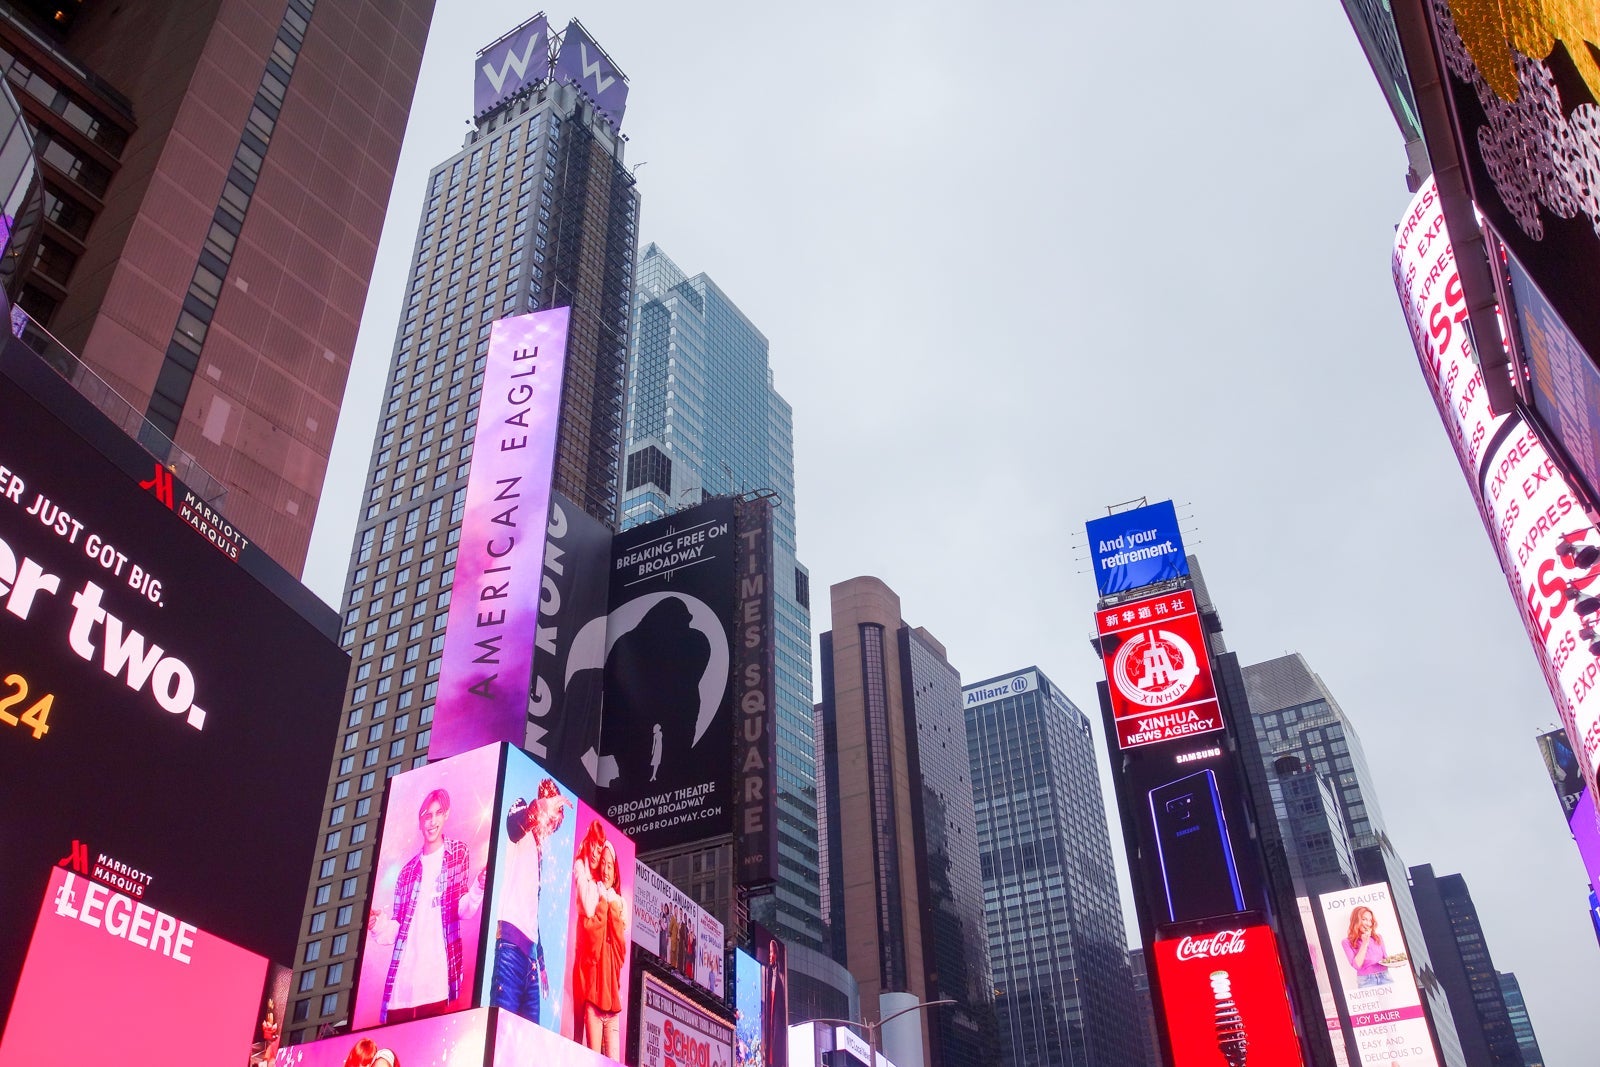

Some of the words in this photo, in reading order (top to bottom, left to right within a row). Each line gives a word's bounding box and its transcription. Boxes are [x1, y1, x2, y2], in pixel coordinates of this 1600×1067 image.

[482, 32, 539, 94] W
[580, 41, 616, 95] W
[181, 508, 239, 559] MARQUIS
[185, 491, 249, 550] MARRIOTT
[467, 476, 522, 700] AMERICAN
[501, 345, 539, 452] EAGLE
[26, 494, 84, 544] JUST
[85, 534, 128, 577] GOT
[128, 564, 164, 608] BIG.
[616, 542, 674, 570] BREAKING
[676, 530, 705, 549] FREE
[708, 523, 728, 538] ON
[1099, 534, 1124, 554] And
[1127, 528, 1158, 549] your
[1101, 540, 1178, 570] retirement.
[638, 544, 704, 576] BROADWAY
[741, 528, 763, 648] TIMES
[1105, 598, 1186, 627] 新华通讯社
[69, 580, 207, 732] two.
[0, 673, 55, 740] 24
[967, 684, 1010, 704] Allianz
[1140, 683, 1187, 703] XINHUA
[1127, 727, 1162, 745] NEWS
[1164, 718, 1214, 738] AGENCY
[1138, 709, 1199, 733] XINHUA
[741, 663, 766, 834] SQUARE
[1176, 748, 1221, 764] SAMSUNG
[617, 791, 672, 815] BROADWAY
[674, 782, 716, 801] THEATRE
[617, 813, 637, 825] 53RD
[638, 808, 656, 820] AND
[658, 796, 706, 816] BROADWAY
[98, 853, 153, 886] MARRIOTT
[744, 854, 764, 865] NYC
[94, 866, 144, 897] MARQUIS
[636, 862, 650, 883] MUST
[651, 874, 671, 899] CLOTHES
[1327, 898, 1346, 910] JOY
[1350, 891, 1386, 905] BAUER
[57, 871, 198, 965] LEGERE
[1176, 929, 1247, 961] Coca-Cola
[1349, 987, 1393, 1001] NUTRITION
[1352, 1002, 1381, 1013] EXPERT
[1356, 1016, 1371, 1025] JOY
[1374, 1011, 1400, 1021] BAUER
[1359, 1026, 1388, 1037] MAKES
[1390, 1024, 1398, 1033] IT
[1362, 1041, 1382, 1050] EASY
[1386, 1037, 1405, 1046] AND
[1365, 1049, 1409, 1063] DELICIOUS
[1411, 1047, 1424, 1056] TO
